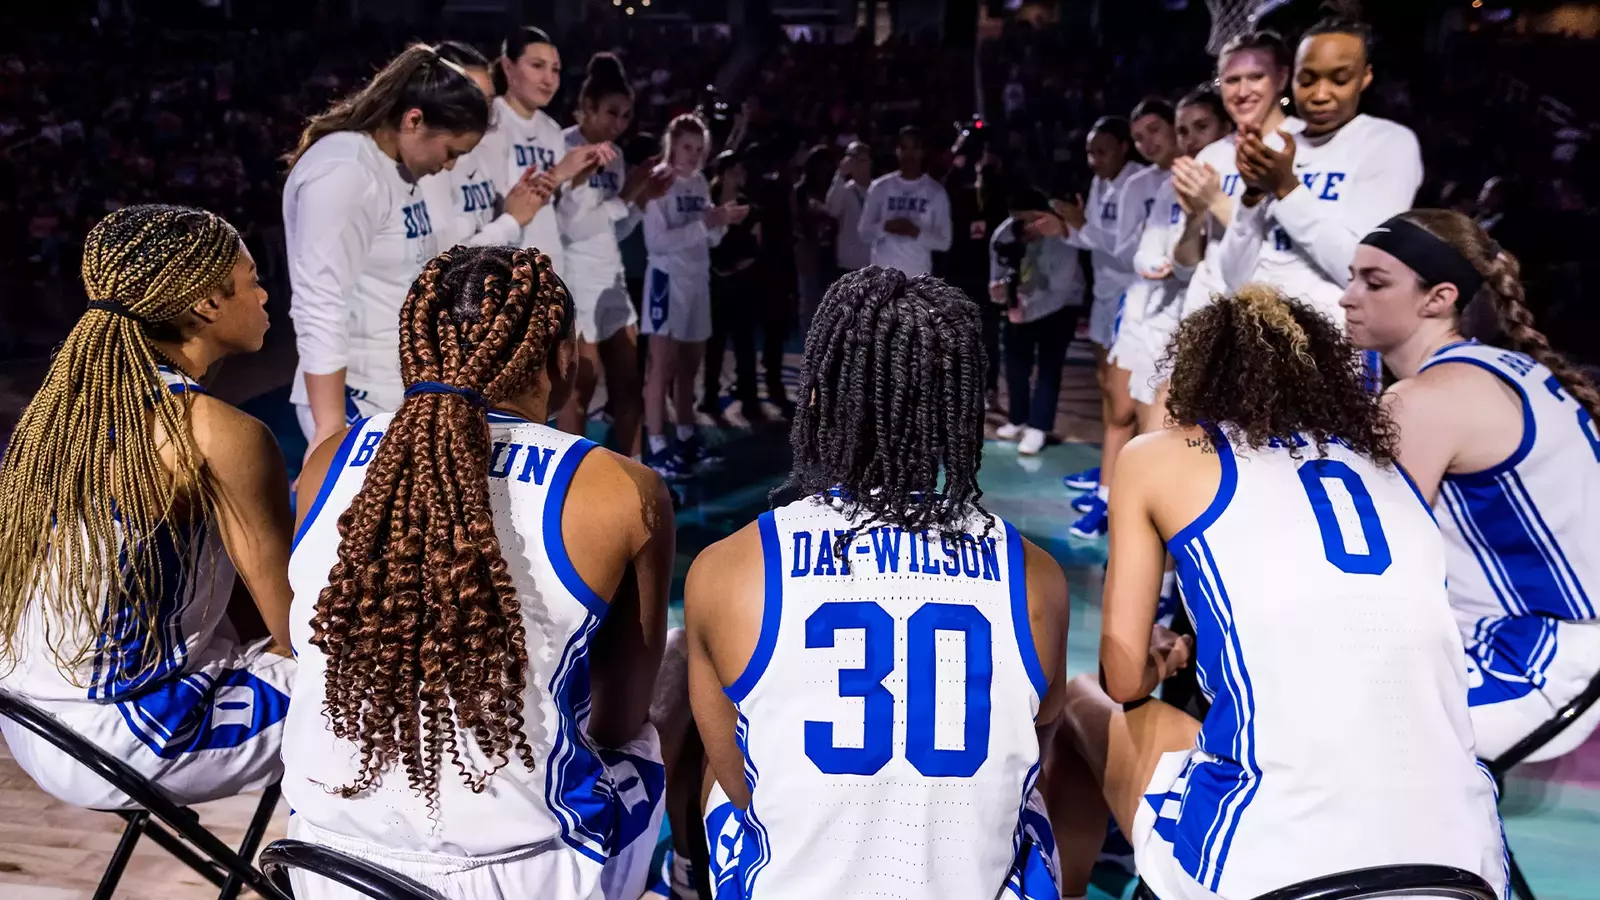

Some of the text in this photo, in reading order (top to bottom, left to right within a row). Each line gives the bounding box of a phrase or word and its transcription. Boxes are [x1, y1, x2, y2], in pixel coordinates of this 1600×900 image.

[790, 526, 1002, 582] DAY-WILSON
[1297, 459, 1393, 576] 0
[803, 600, 993, 778] 30
